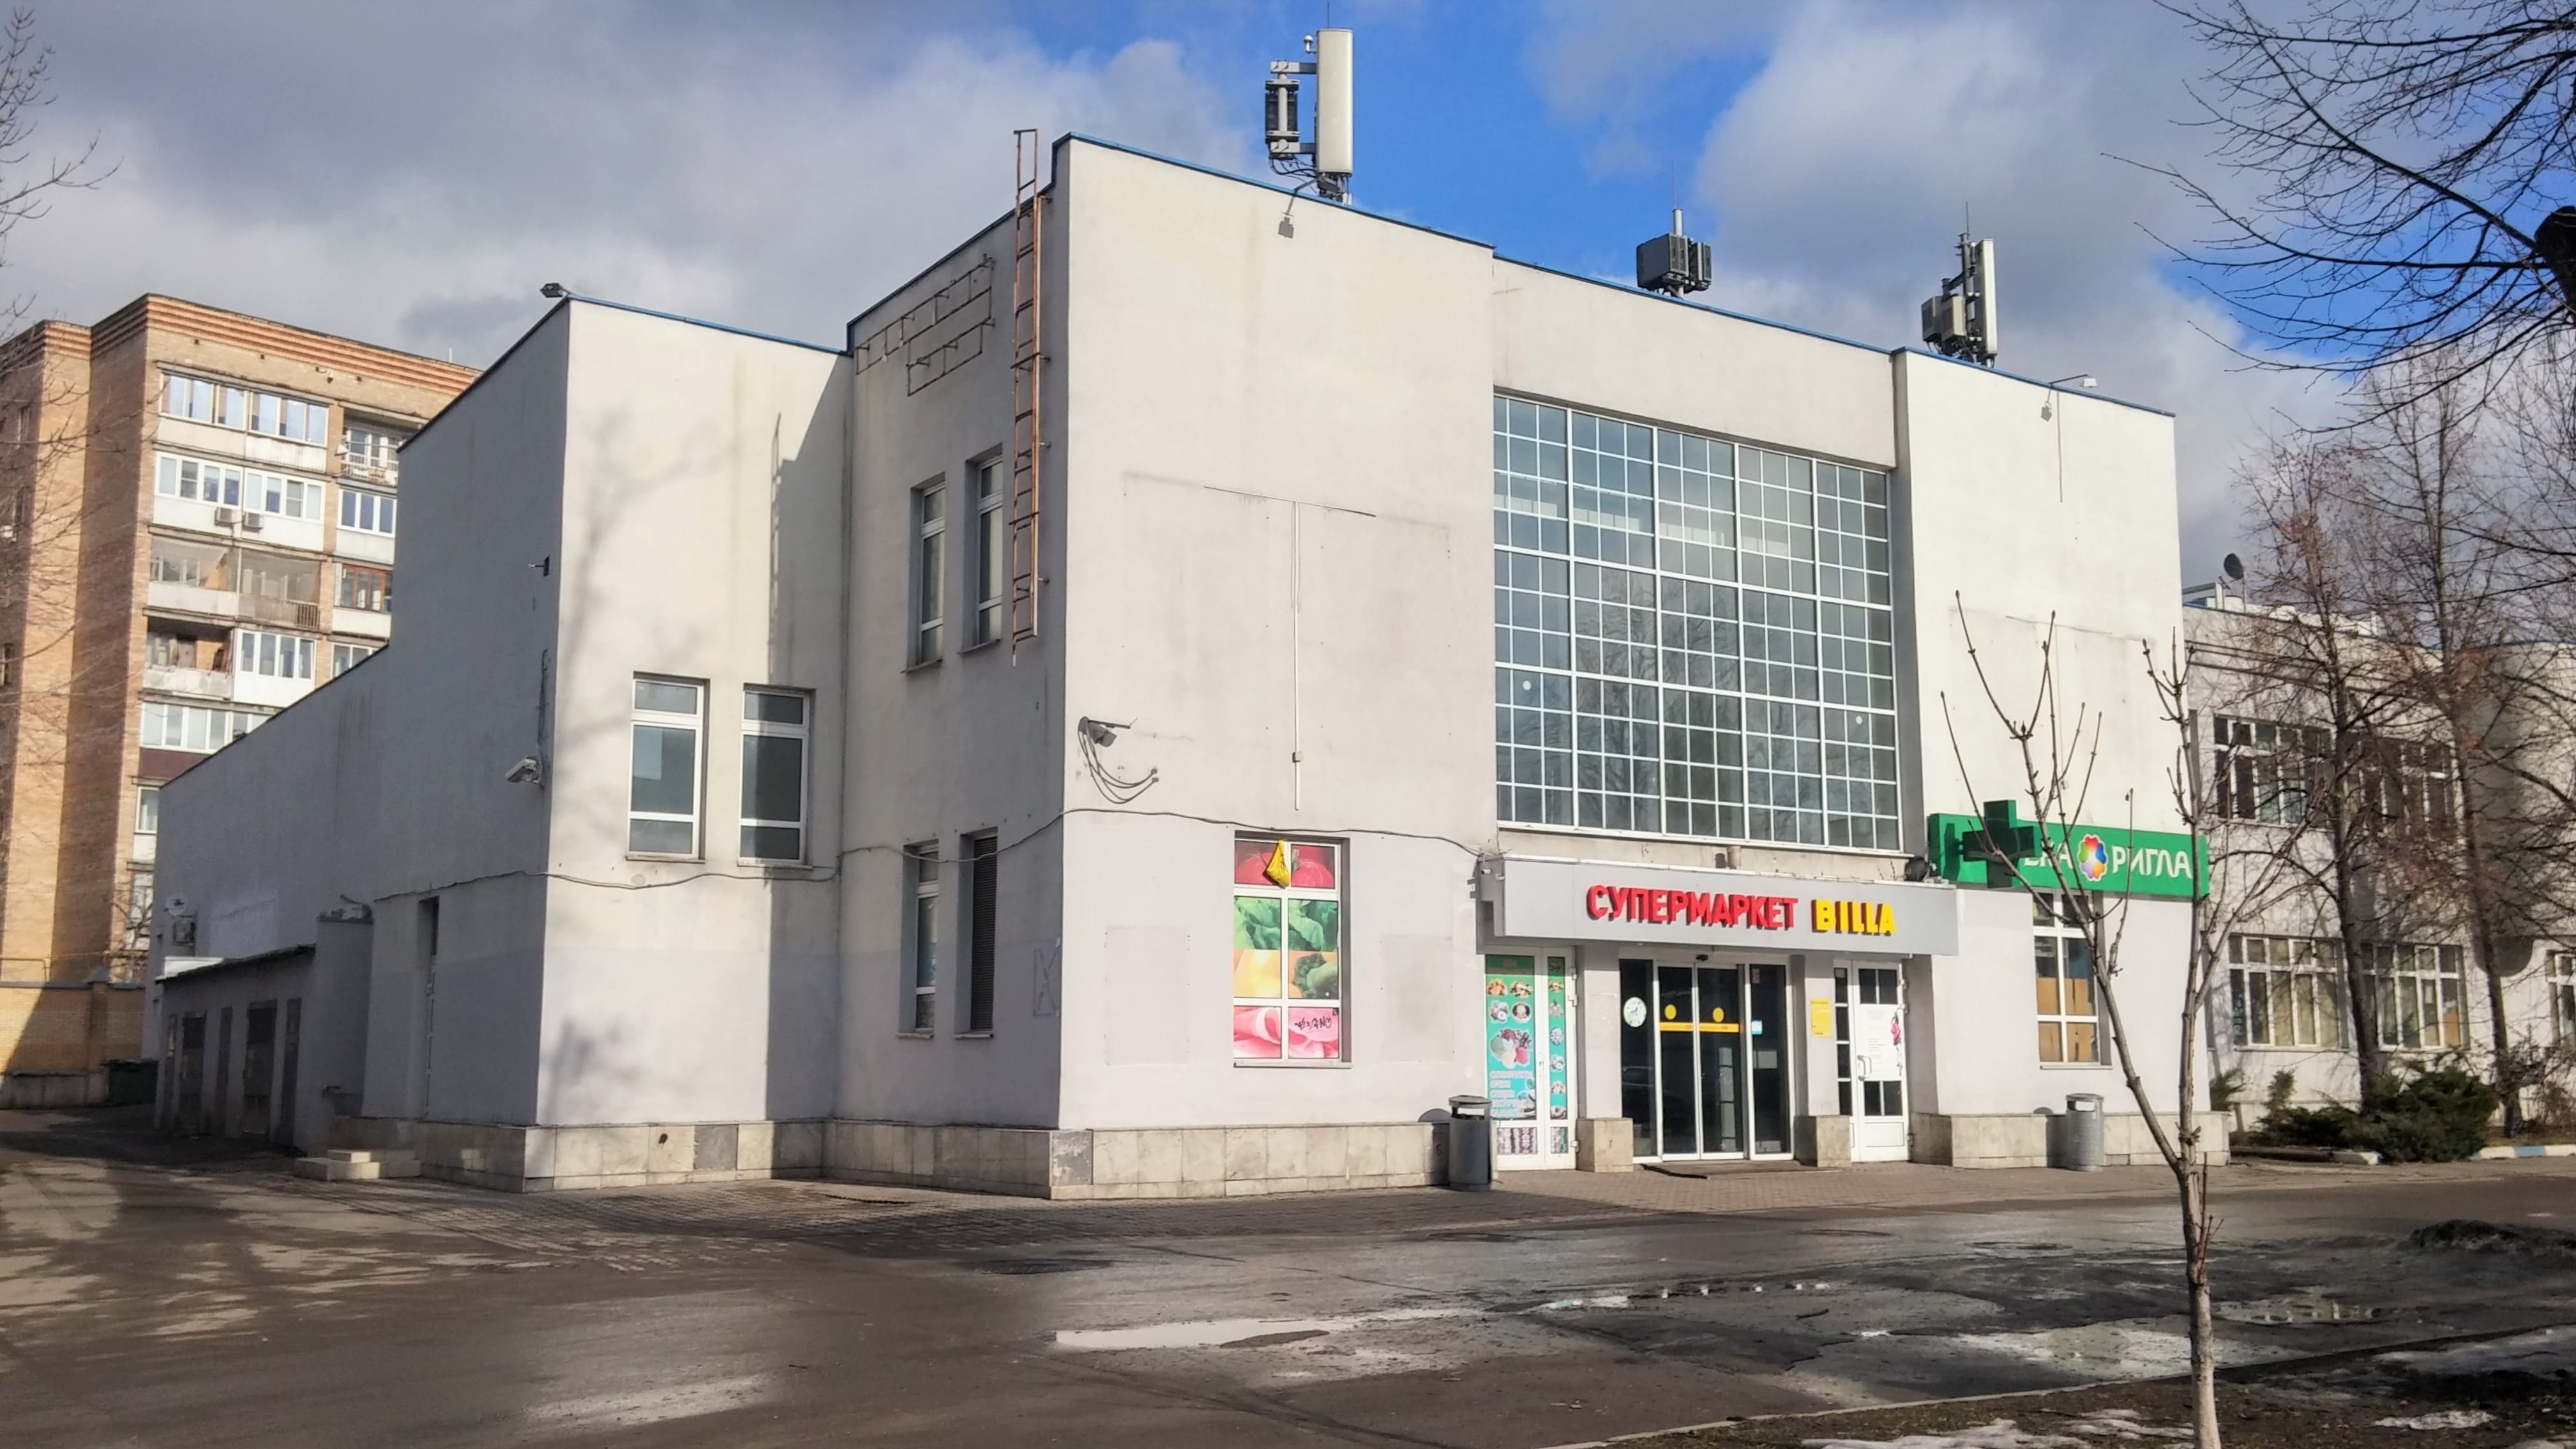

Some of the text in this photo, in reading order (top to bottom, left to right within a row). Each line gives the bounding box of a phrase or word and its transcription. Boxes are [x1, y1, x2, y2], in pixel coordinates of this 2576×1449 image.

[2112, 845, 2192, 879] РИГЛА
[1587, 885, 1896, 934] СУПЕРМАРКЕТ BILLA
